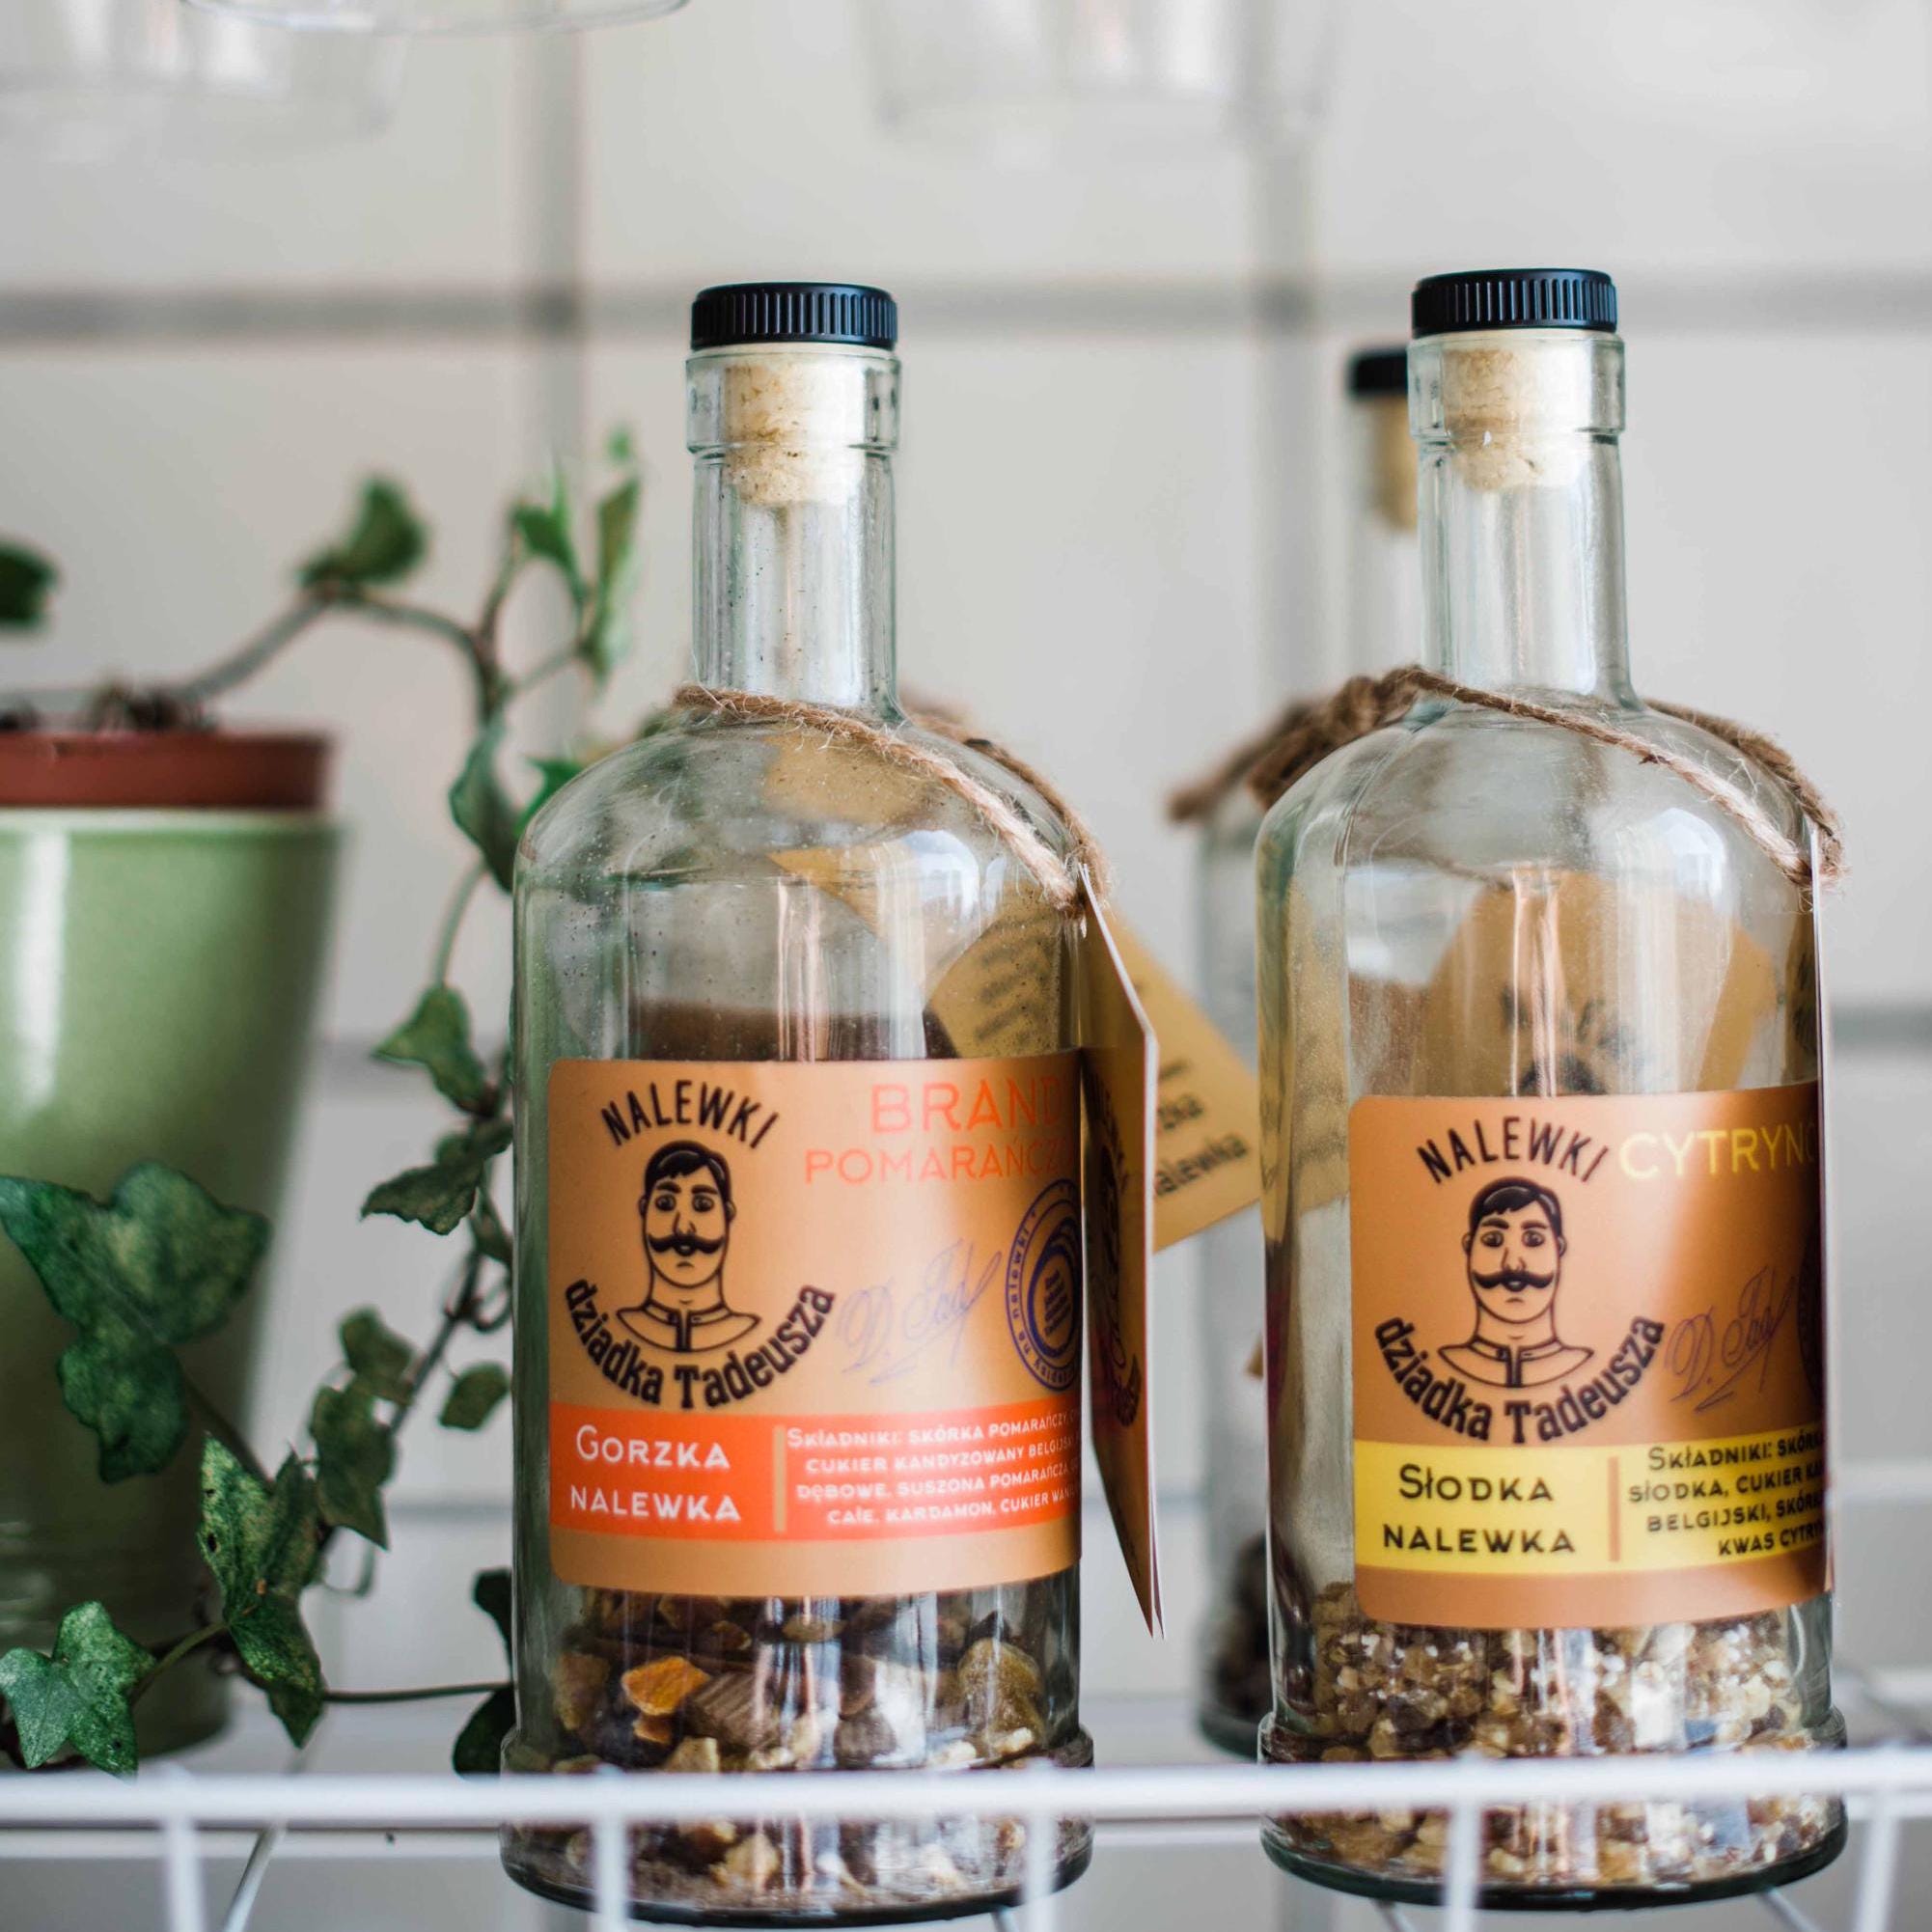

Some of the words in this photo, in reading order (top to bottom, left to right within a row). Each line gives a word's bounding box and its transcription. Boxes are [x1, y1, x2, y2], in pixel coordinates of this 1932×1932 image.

[600, 1080, 780, 1148] NALEWKI
[1417, 1117, 1609, 1184] NALEWKI
[565, 1278, 665, 1405] dziadka
[673, 1284, 837, 1410] Tadeusza
[1374, 1316, 1493, 1441] dziadka
[1504, 1315, 1665, 1444] Tadeusza
[576, 1423, 731, 1469] GORZKA
[908, 1423, 984, 1446] SKÓRKA
[805, 1456, 888, 1475] CUKIER
[894, 1446, 1025, 1473] KANDYZOWANY
[897, 1477, 985, 1497] SUSZONA
[1736, 1466, 1803, 1494] CUKIER
[570, 1483, 742, 1522] NALEWKA
[1000, 1492, 1049, 1513] CUKIER
[1383, 1524, 1576, 1553] NALEWKA
[1718, 1532, 1776, 1557] KWAS
